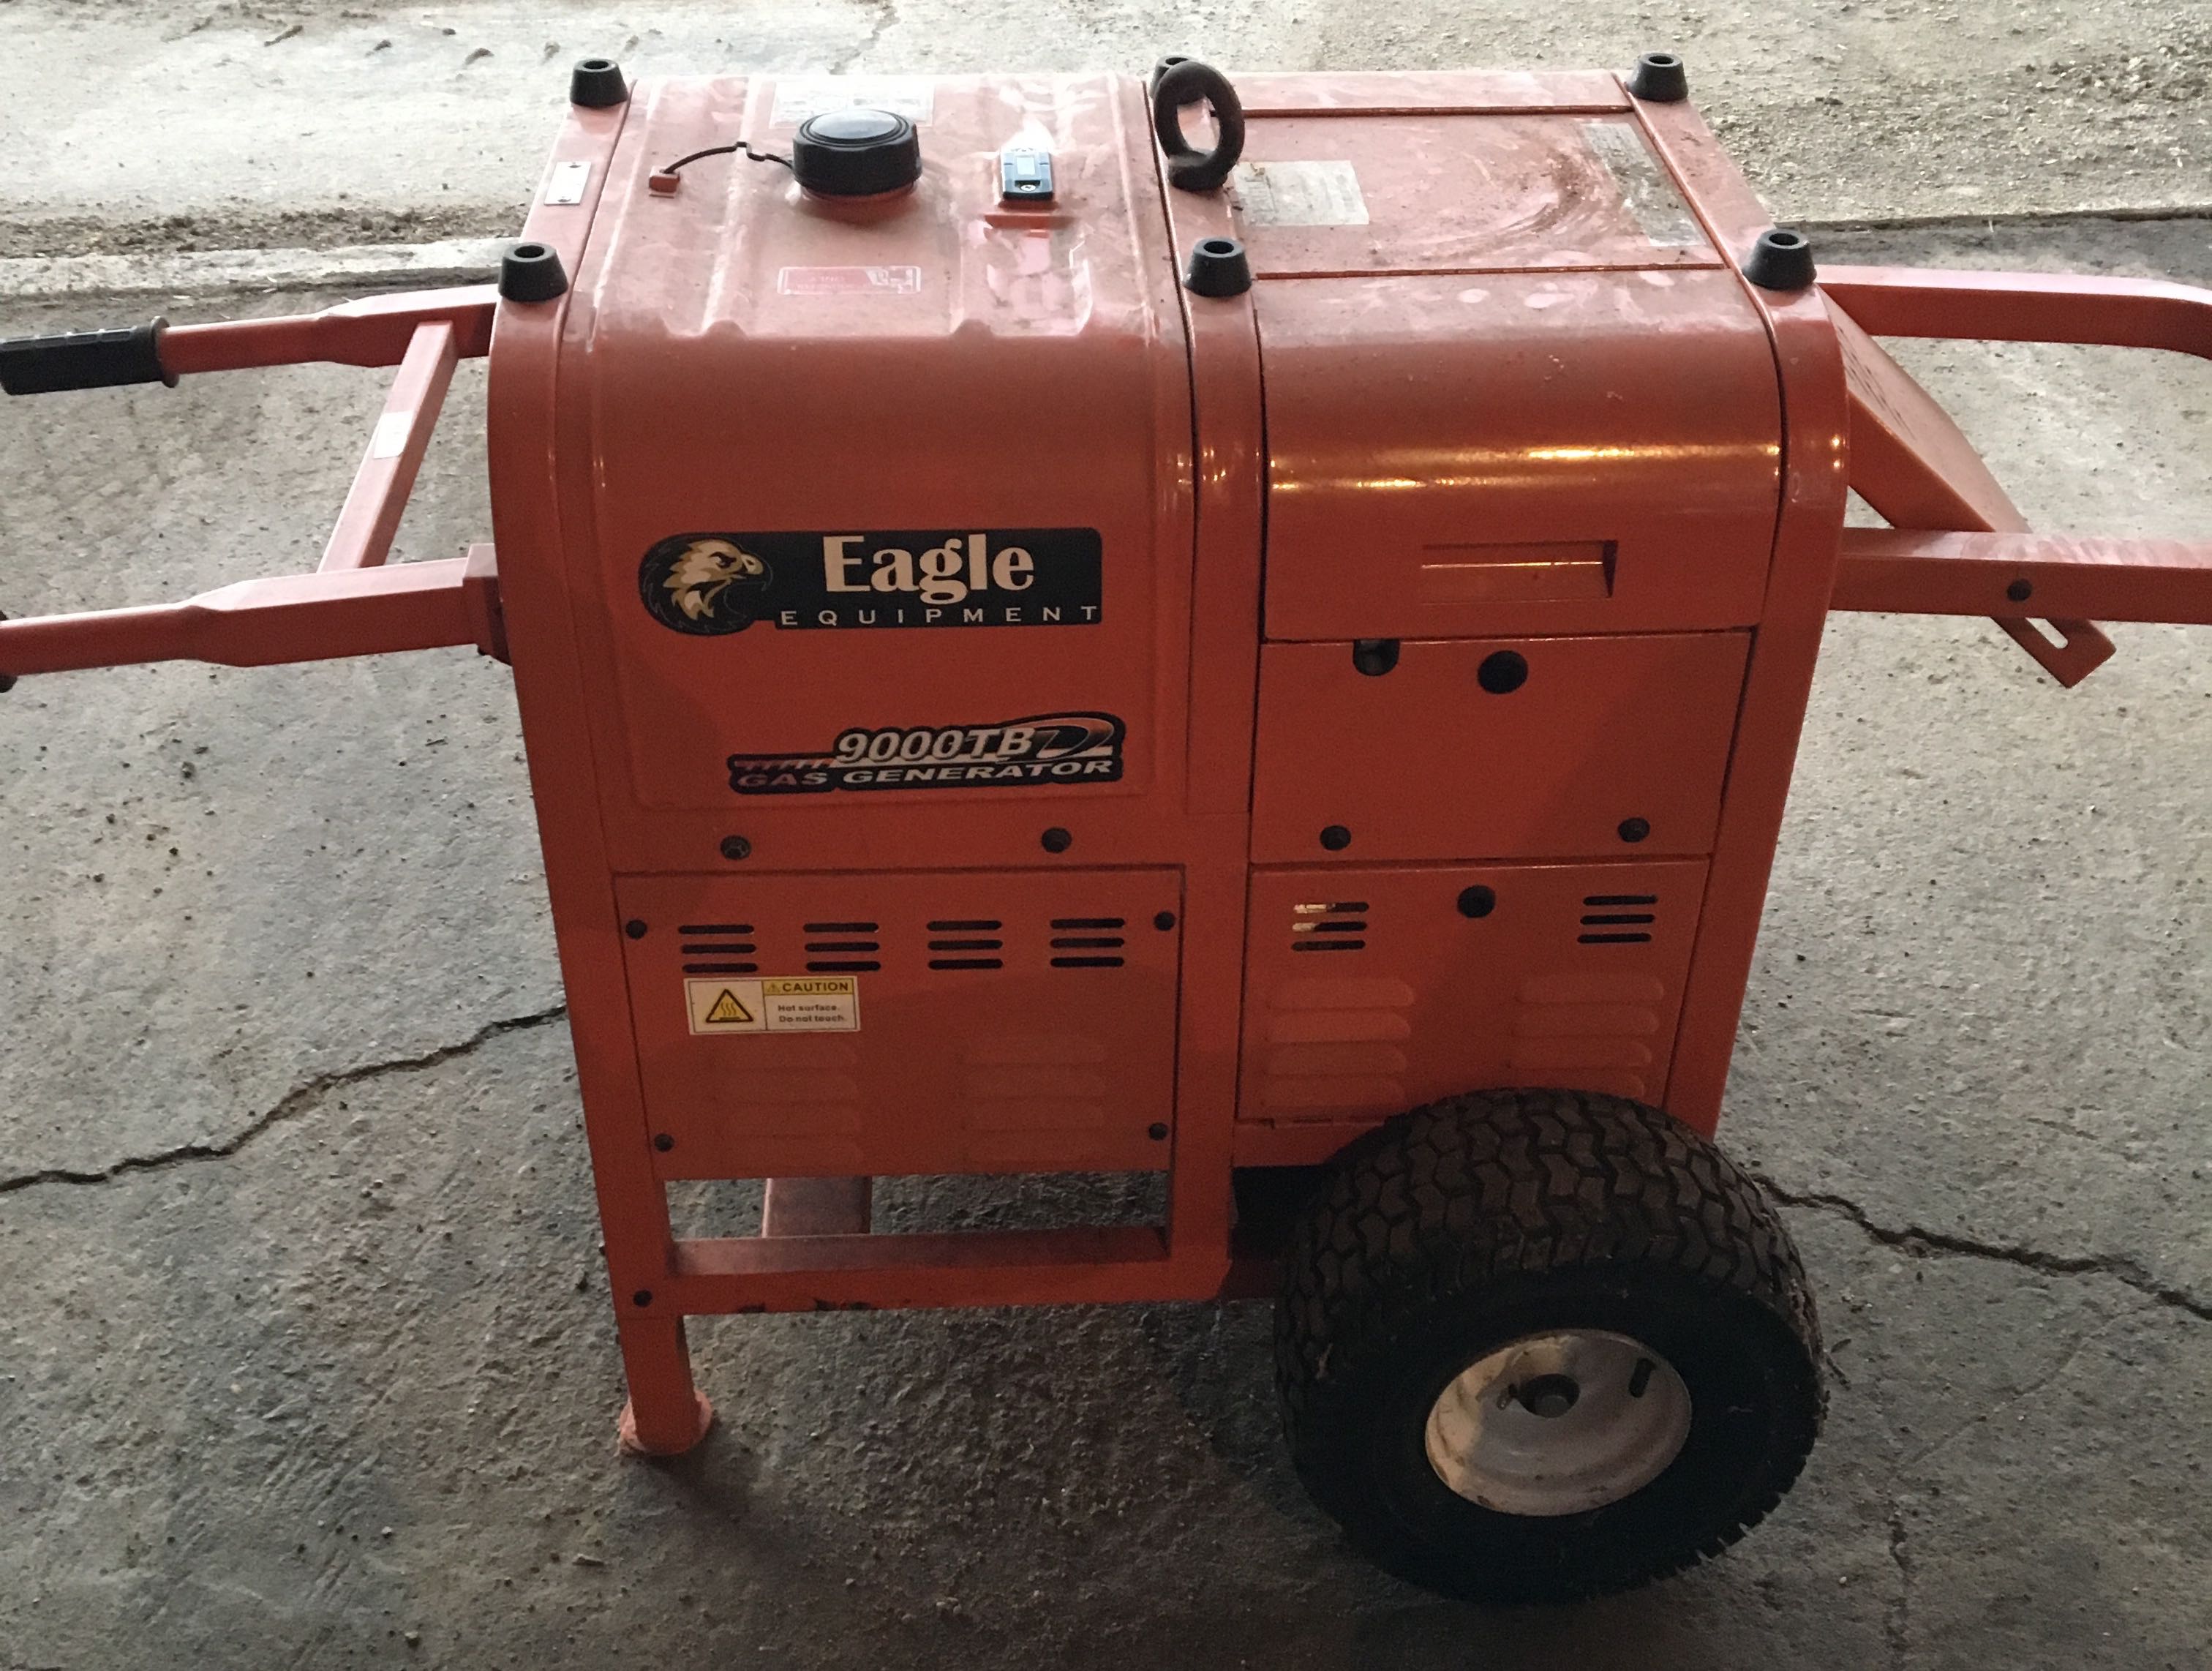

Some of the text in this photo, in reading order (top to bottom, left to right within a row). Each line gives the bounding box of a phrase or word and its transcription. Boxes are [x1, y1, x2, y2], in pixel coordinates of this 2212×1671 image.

[823, 533, 1034, 604] Eagle
[780, 605, 1098, 626] EQUIPMENT
[835, 727, 1035, 762] 9000TB
[737, 760, 1113, 786] GAS GENERATOR
[782, 982, 849, 992] CAUTION
